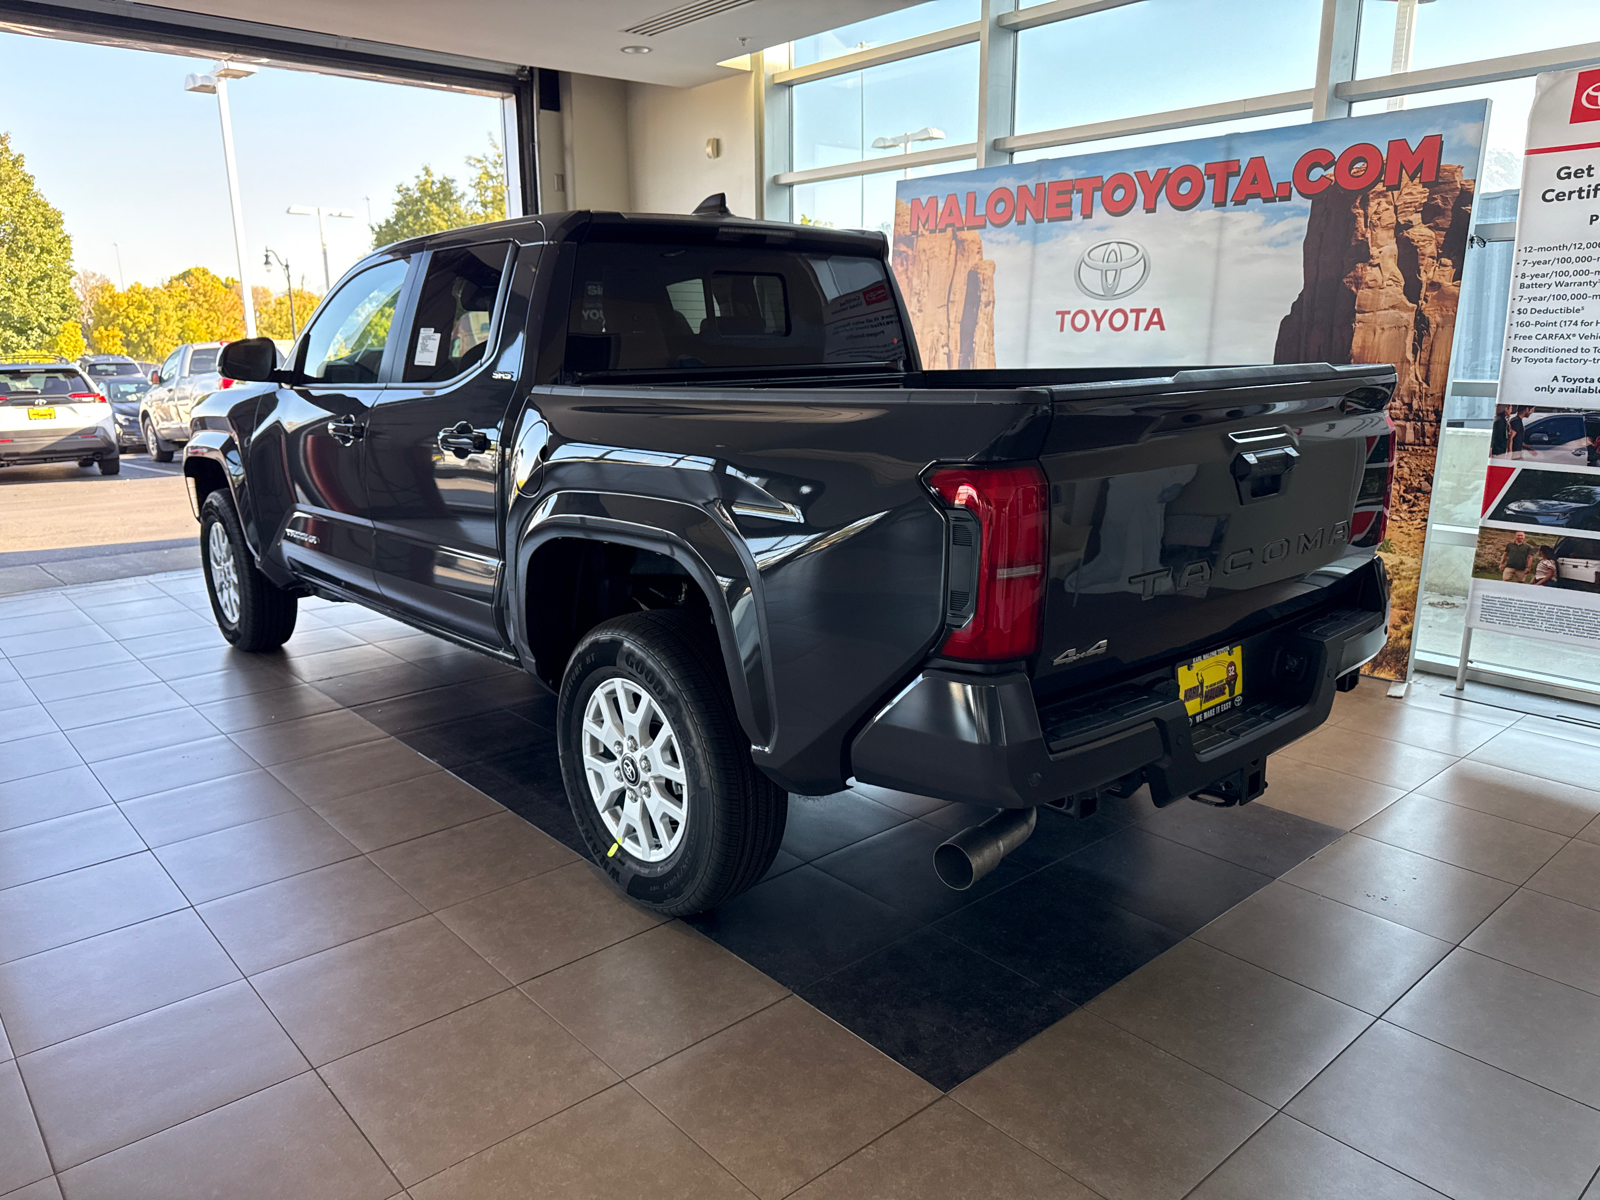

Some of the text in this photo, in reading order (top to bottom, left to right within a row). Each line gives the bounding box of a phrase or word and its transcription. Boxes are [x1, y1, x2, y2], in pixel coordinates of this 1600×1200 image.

[1556, 164, 1595, 181] Get
[909, 133, 1445, 235] MALONETOYOTA.COM
[1519, 282, 1553, 290] Battery
[1516, 307, 1528, 316] $0
[1055, 307, 1166, 333] TOYOTA
[1516, 320, 1558, 328] 160-Point
[1560, 320, 1578, 328] (174
[1512, 346, 1578, 354] Reconditioned
[1510, 356, 1522, 364] by
[1524, 356, 1554, 365] Toyota
[1562, 376, 1595, 385] Toyota
[1534, 385, 1556, 394] only
[1128, 519, 1352, 601] TACOMA
[1052, 639, 1108, 666] 4x4
[1228, 666, 1235, 676] 32
[1196, 700, 1232, 723] WE MAKE IT EASY
